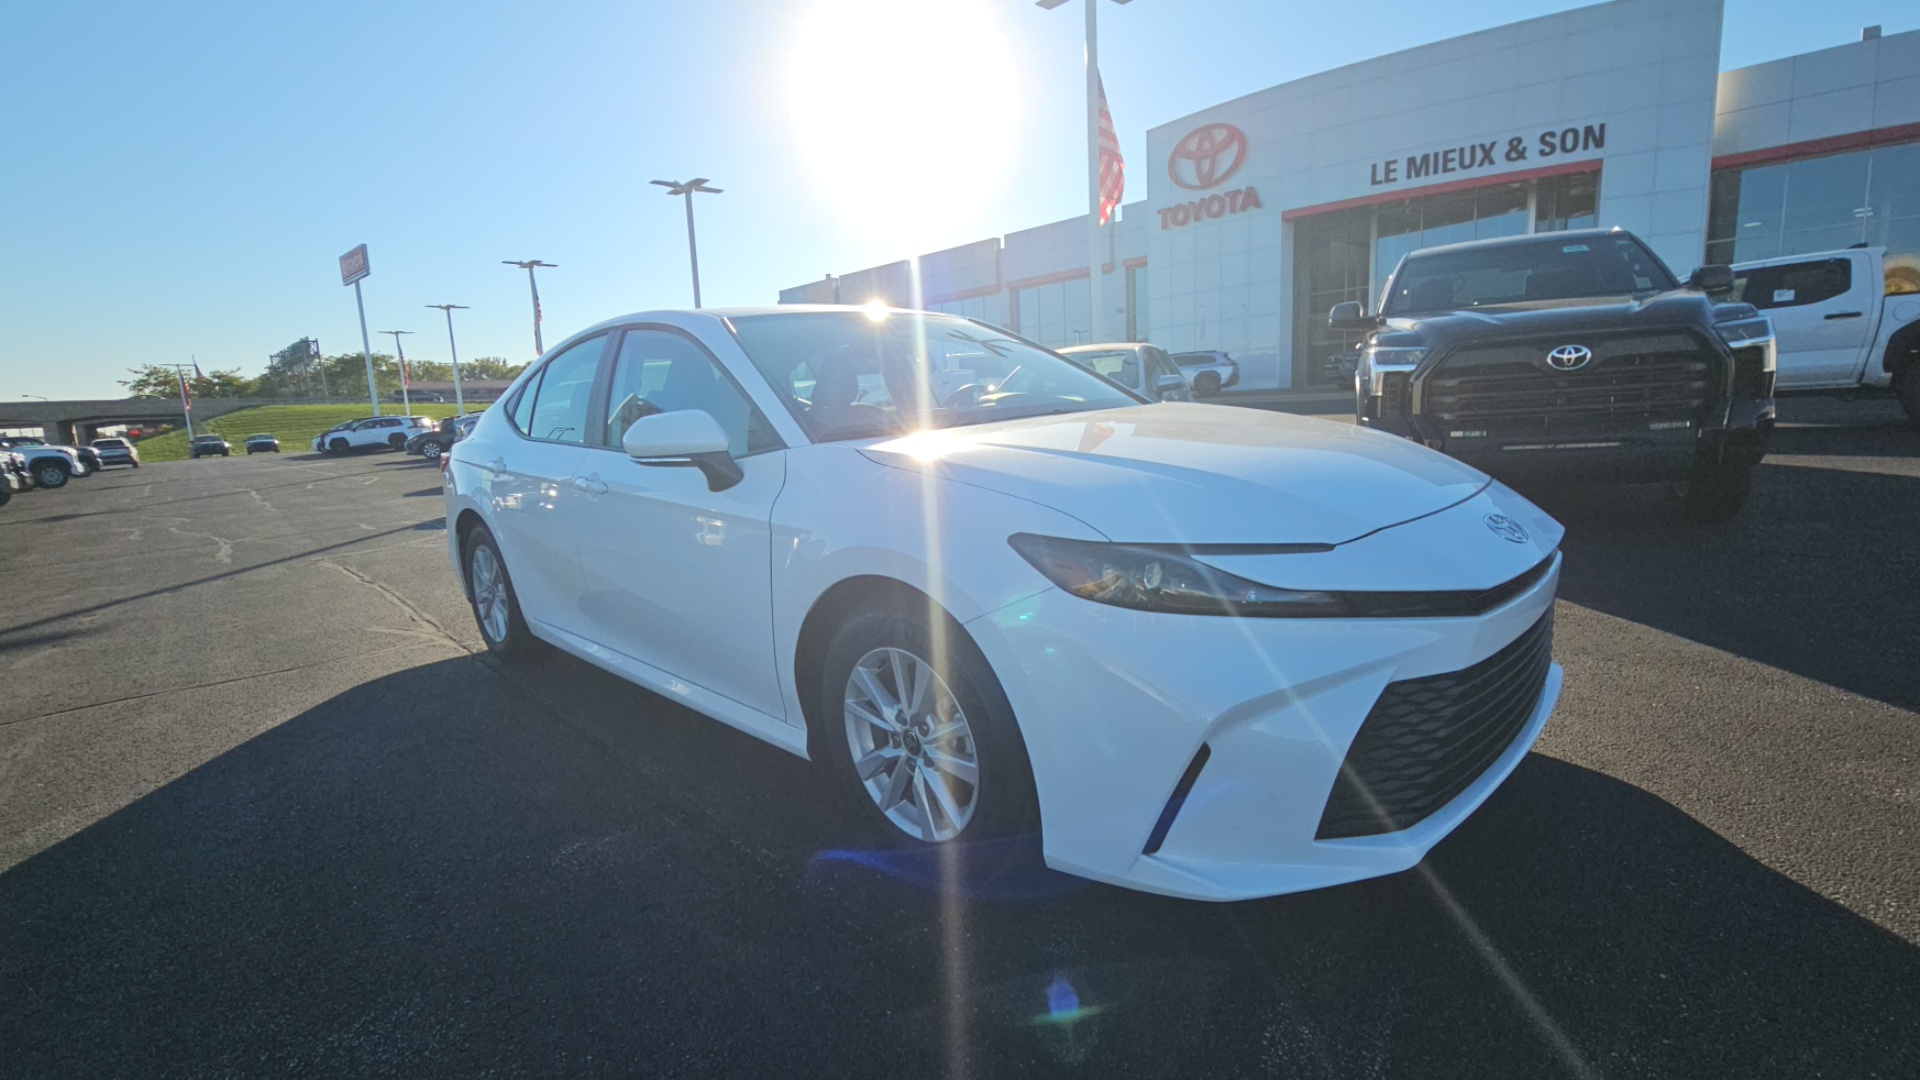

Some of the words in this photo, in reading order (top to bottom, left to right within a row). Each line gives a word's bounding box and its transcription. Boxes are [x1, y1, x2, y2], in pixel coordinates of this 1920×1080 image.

[1370, 159, 1399, 186] LE
[1406, 141, 1498, 180] MIEUX
[1505, 136, 1528, 162] &
[1538, 123, 1606, 157] SON
[1157, 186, 1263, 230] TOYOTA
